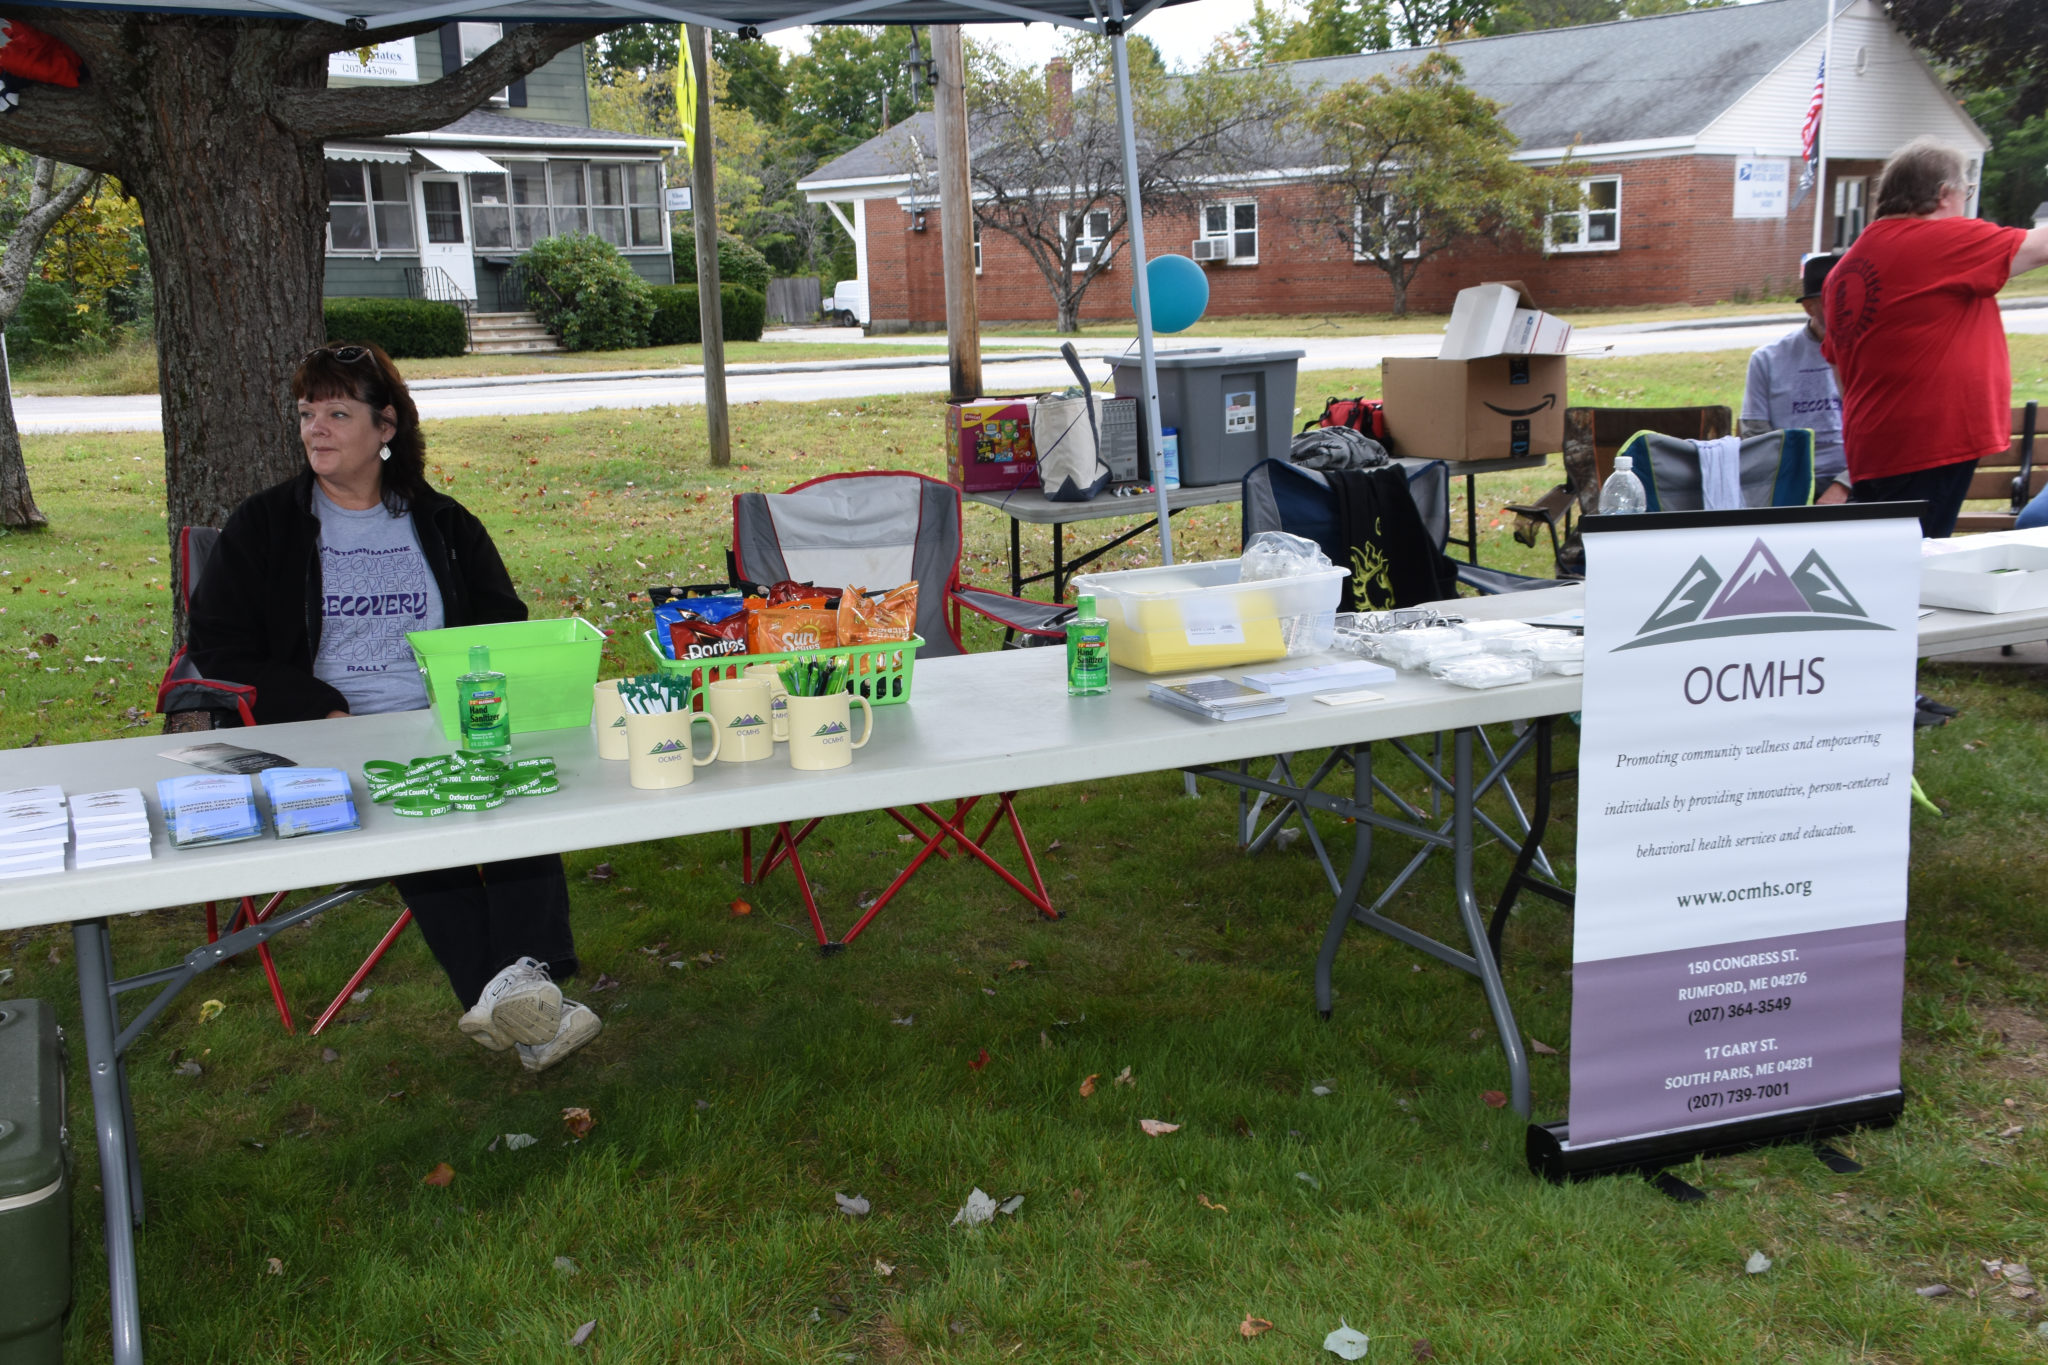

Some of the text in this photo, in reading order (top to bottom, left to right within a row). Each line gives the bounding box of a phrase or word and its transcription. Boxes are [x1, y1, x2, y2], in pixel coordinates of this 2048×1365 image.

[370, 545, 411, 556] MAINE
[688, 637, 747, 660] Doritos
[781, 631, 815, 652] Sun
[1077, 648, 1094, 656] Hand
[346, 664, 389, 672] RALLY
[1077, 656, 1103, 664] Sanitizer
[1683, 656, 1826, 705] OCMHS
[470, 705, 488, 714] Hand
[470, 714, 500, 723] Sanitizer
[736, 728, 761, 737] OCMHS
[822, 736, 845, 745] OCMHS
[657, 754, 682, 764] OCMHS
[1616, 730, 1882, 769] Promoting community wellness and empowering
[408, 788, 429, 796] County
[470, 793, 488, 801] County
[1604, 773, 1890, 816] individuals by providing innovative, person-centered
[402, 805, 447, 816] Services (207)
[1636, 823, 1857, 859] behavioral health services and education.
[1677, 879, 1813, 908] www.ocmhs.org
[1688, 949, 1800, 975] 150 CONGRESS ST.
[1678, 971, 1808, 1002] RUMFORD, ME 04276
[1688, 996, 1792, 1026] (207) 364-3549
[1704, 1038, 1778, 1060] 17 GARY ST.
[1665, 1056, 1814, 1090] SOUTH PARIS, ME 04281
[1687, 1082, 1790, 1112] (207) 739-7001
